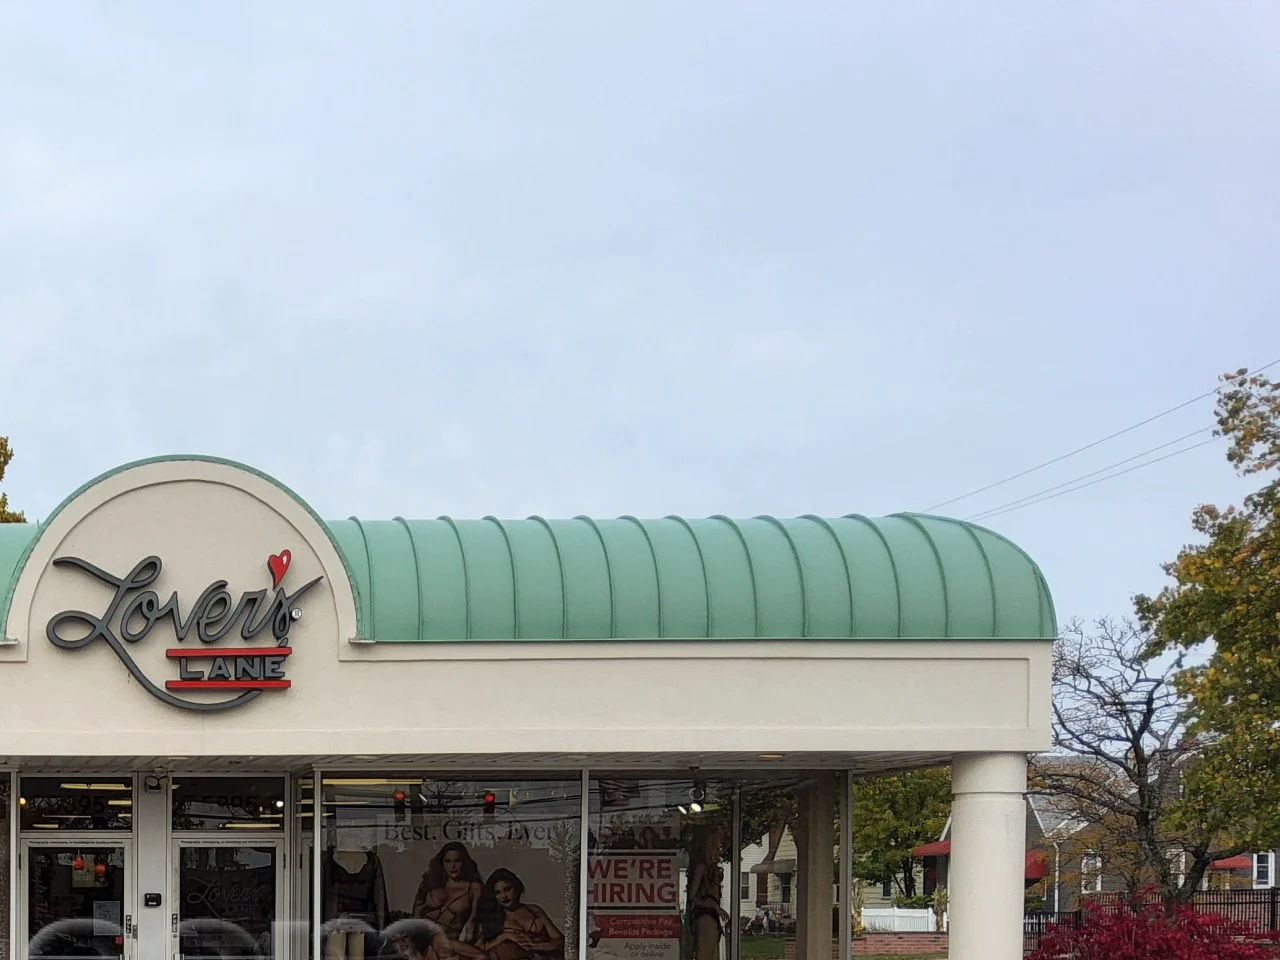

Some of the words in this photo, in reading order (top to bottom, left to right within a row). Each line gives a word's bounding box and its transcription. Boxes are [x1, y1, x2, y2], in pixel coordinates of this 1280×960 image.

[179, 655, 286, 681] LANE
[587, 858, 672, 879] WE'RE
[587, 883, 677, 903] HIRING
